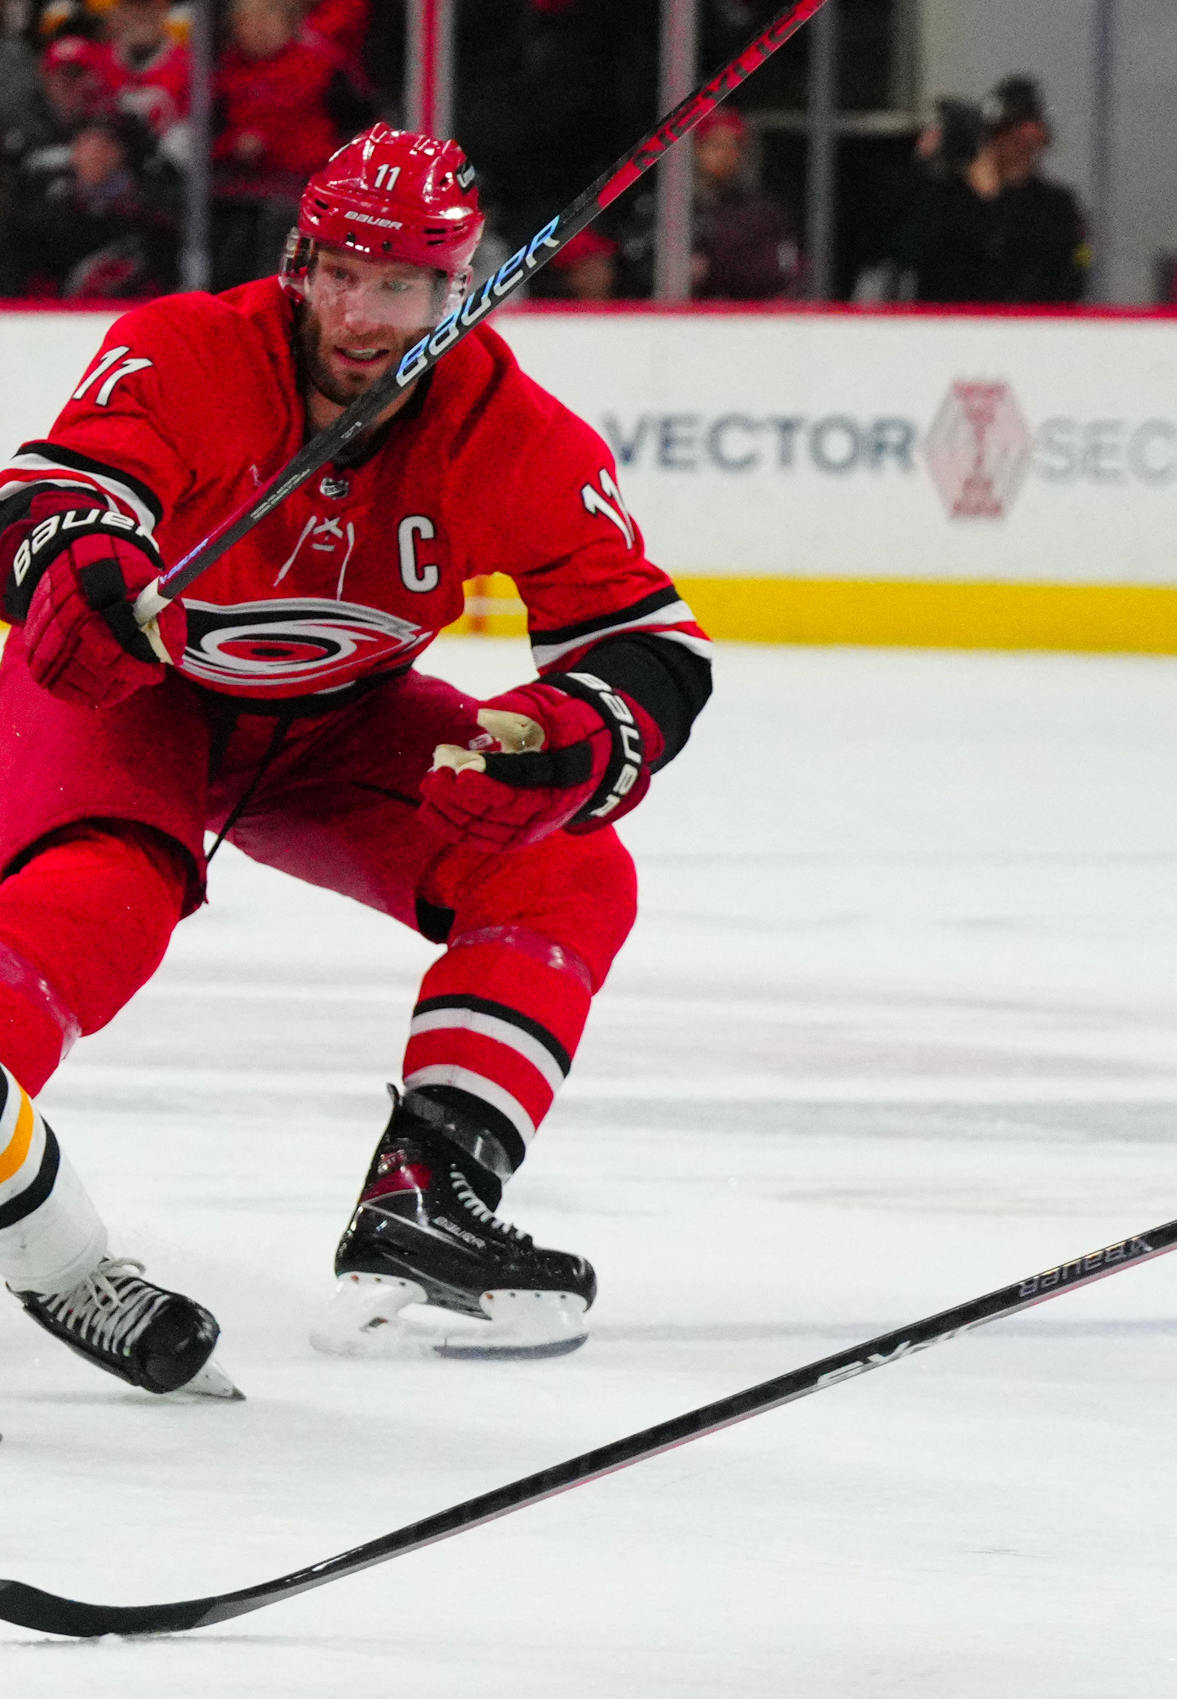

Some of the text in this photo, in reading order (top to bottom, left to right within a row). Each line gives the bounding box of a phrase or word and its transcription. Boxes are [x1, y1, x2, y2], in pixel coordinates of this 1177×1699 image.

[374, 163, 401, 191] 11
[344, 210, 403, 230] BAUER
[395, 214, 560, 388] BAUER
[72, 345, 154, 407] 11
[601, 411, 1177, 488] VECTOR SEC
[581, 468, 635, 550] 11
[398, 515, 440, 593] C
